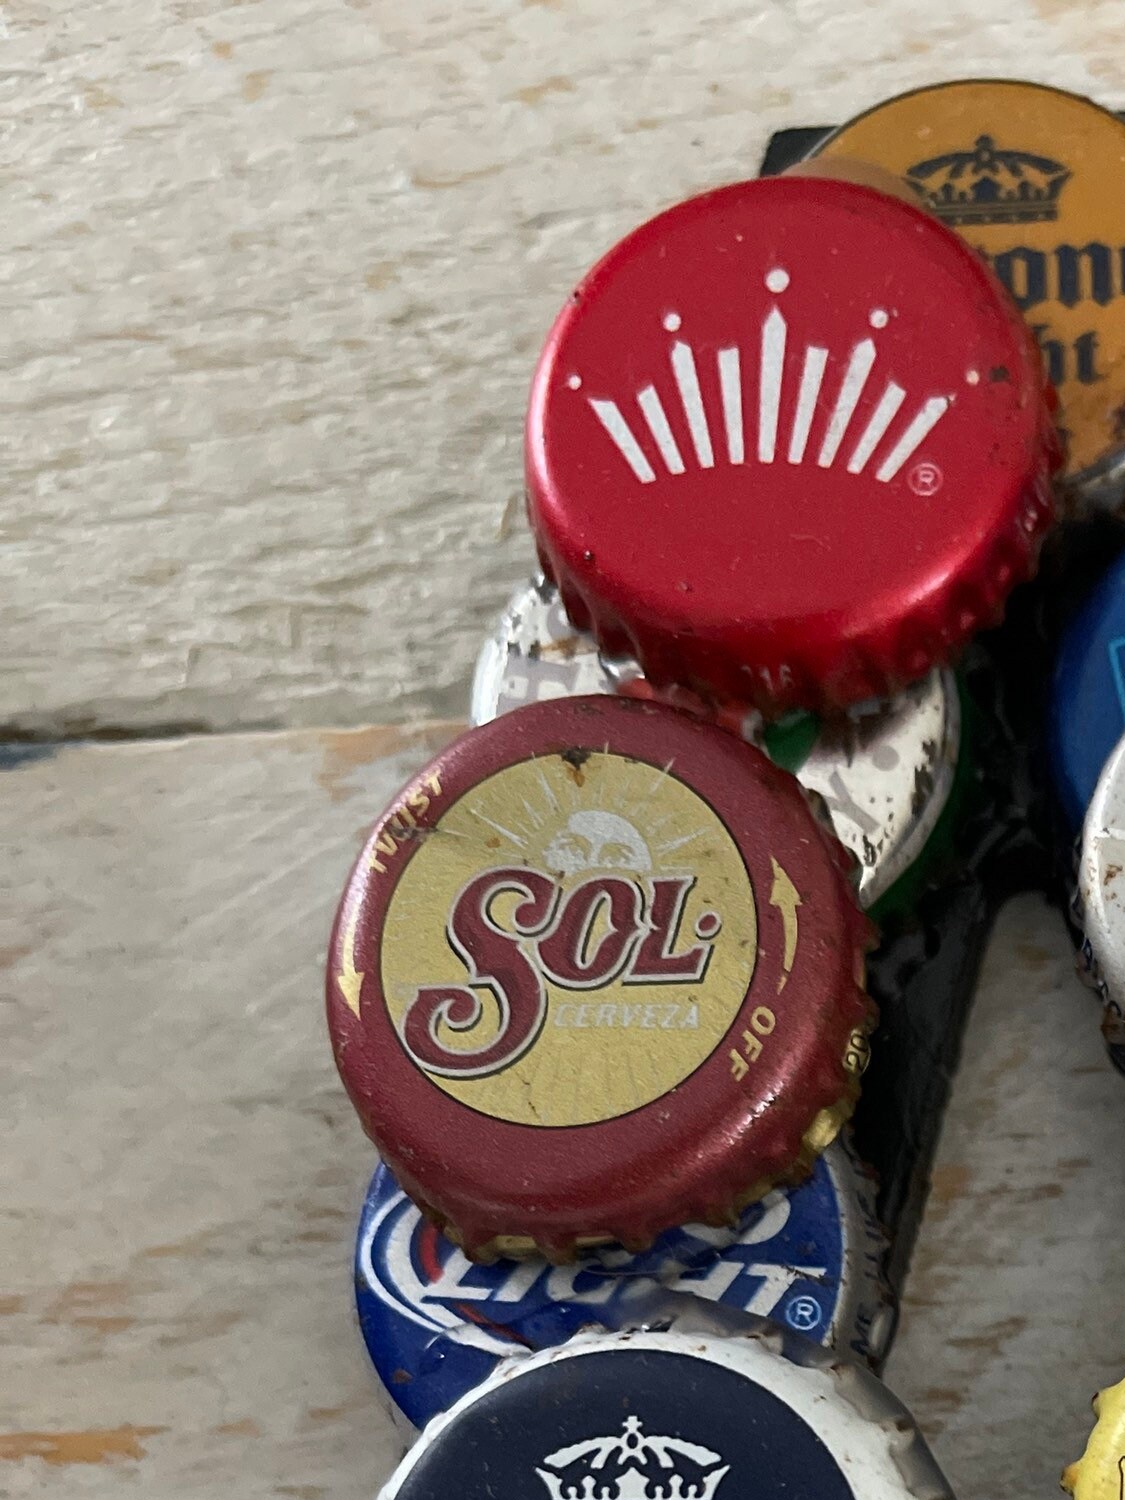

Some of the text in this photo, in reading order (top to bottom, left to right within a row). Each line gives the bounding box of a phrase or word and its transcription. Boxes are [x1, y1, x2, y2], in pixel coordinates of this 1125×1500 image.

[366, 766, 443, 875] TWIST
[553, 1002, 700, 1031] CERVEZA
[729, 1006, 776, 1082] OFF
